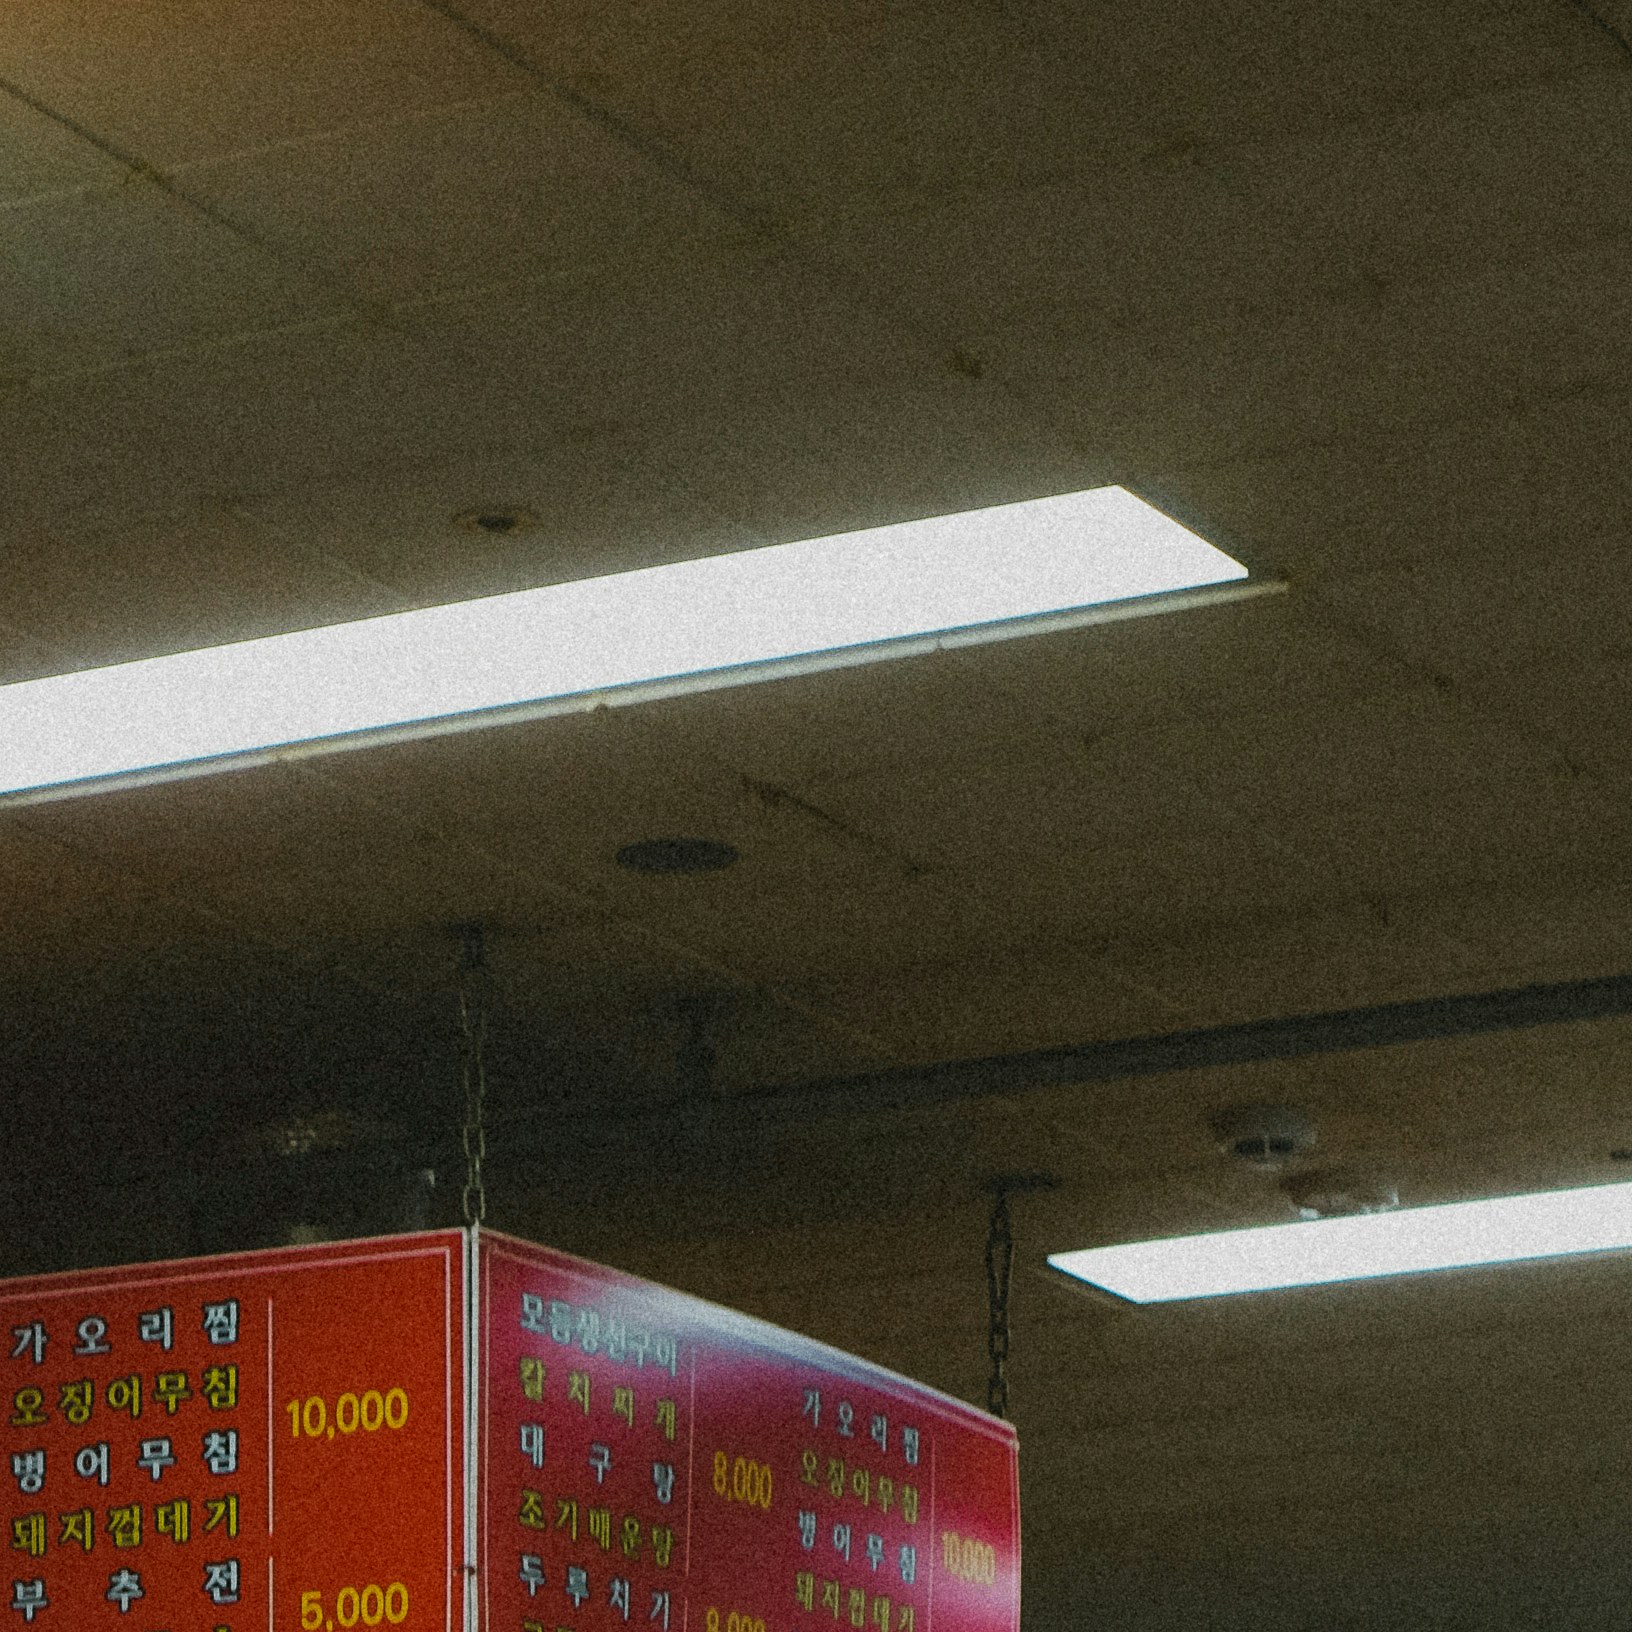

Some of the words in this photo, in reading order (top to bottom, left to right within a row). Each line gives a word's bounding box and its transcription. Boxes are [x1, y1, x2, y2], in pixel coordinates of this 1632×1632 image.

[11, 1300, 240, 1366] 가오리찜
[11, 1365, 239, 1428] 오징어무침
[287, 1387, 409, 1439] 10,000
[12, 1431, 240, 1494] 병어무침
[712, 1451, 772, 1509] 8,000
[12, 1494, 240, 1557] 돼지껍데기
[12, 1558, 240, 1621] 부추전
[300, 1582, 409, 1632] 5,000
